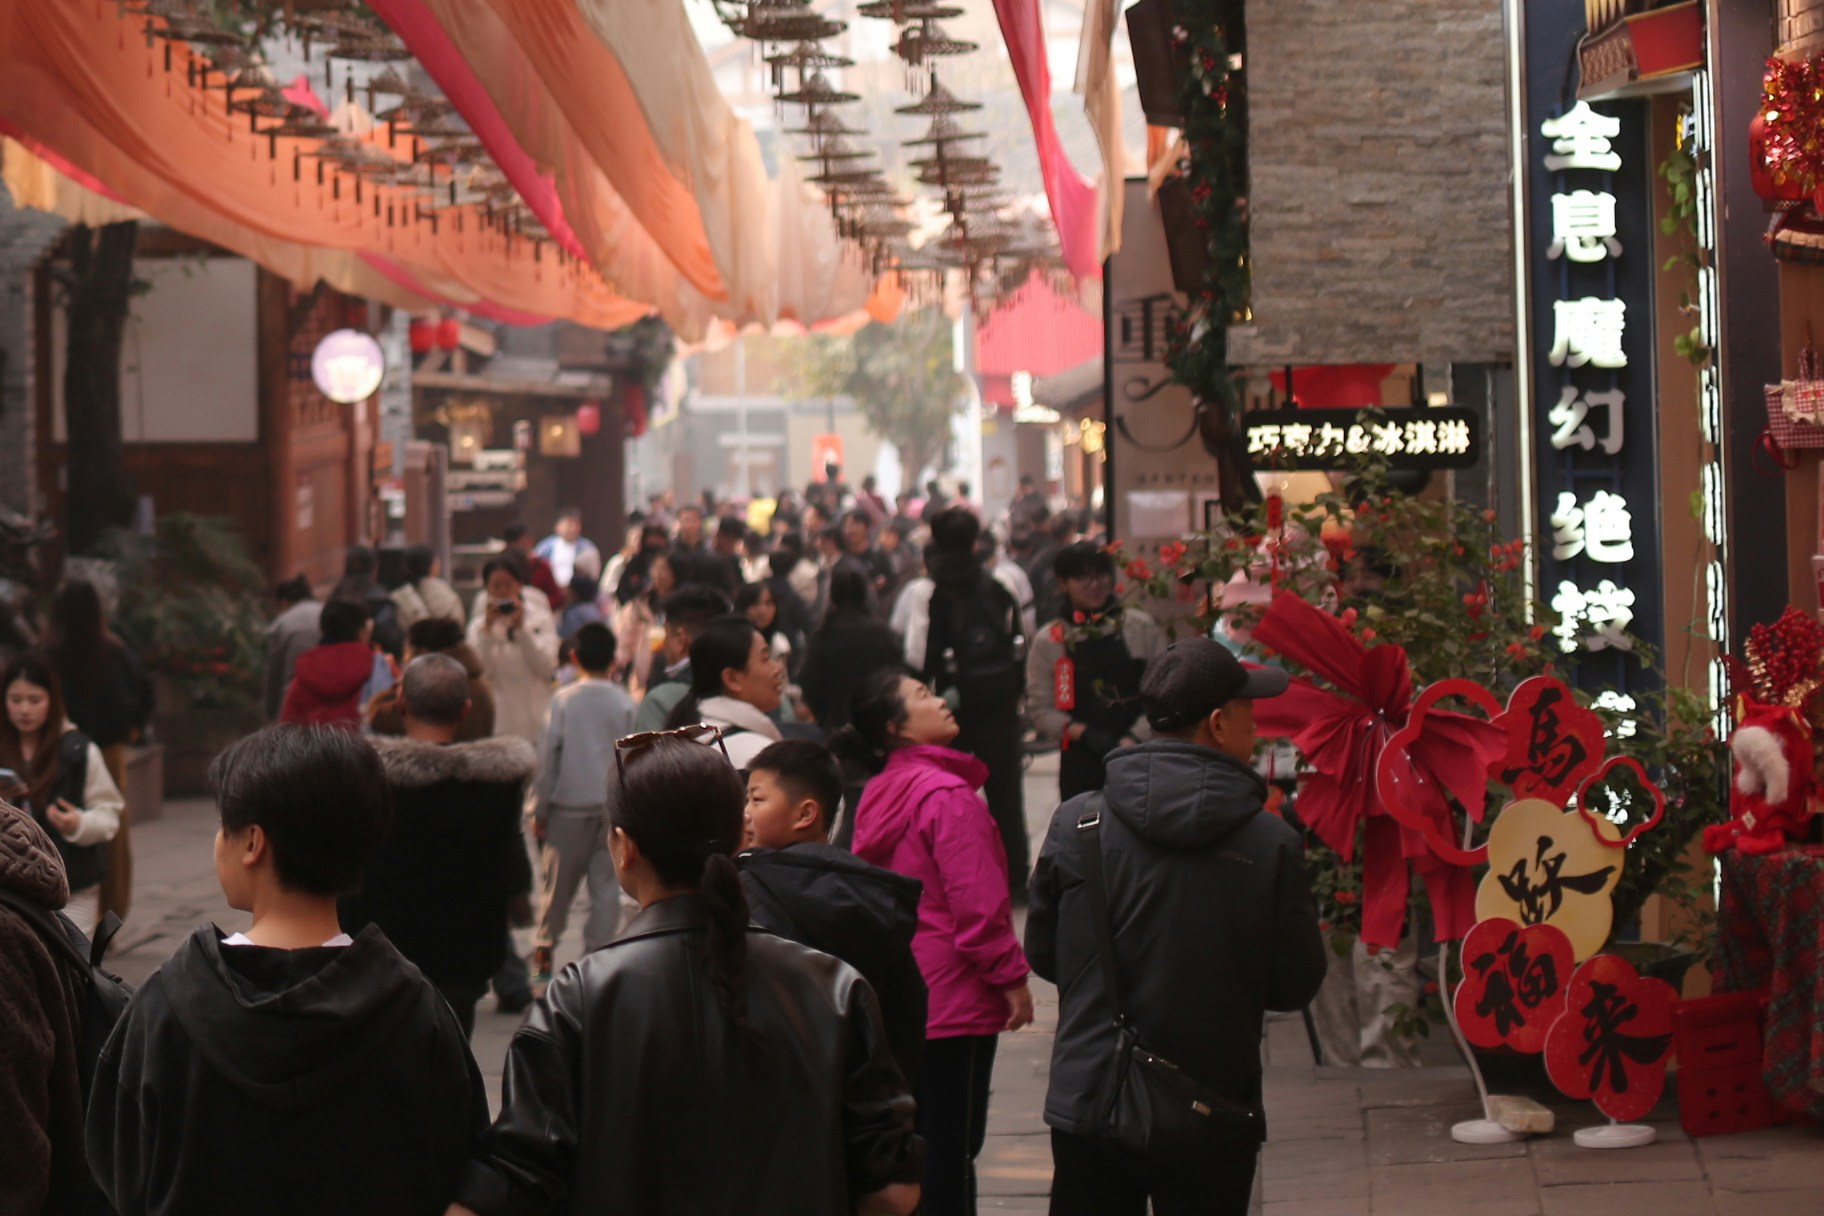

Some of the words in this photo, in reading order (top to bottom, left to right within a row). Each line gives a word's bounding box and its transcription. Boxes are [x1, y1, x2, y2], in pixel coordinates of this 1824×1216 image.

[1246, 418, 1471, 458] 巧克力&冰淇淋
[1540, 99, 1638, 850] 全息魔幻绝技
[1578, 980, 1674, 1095] 来
